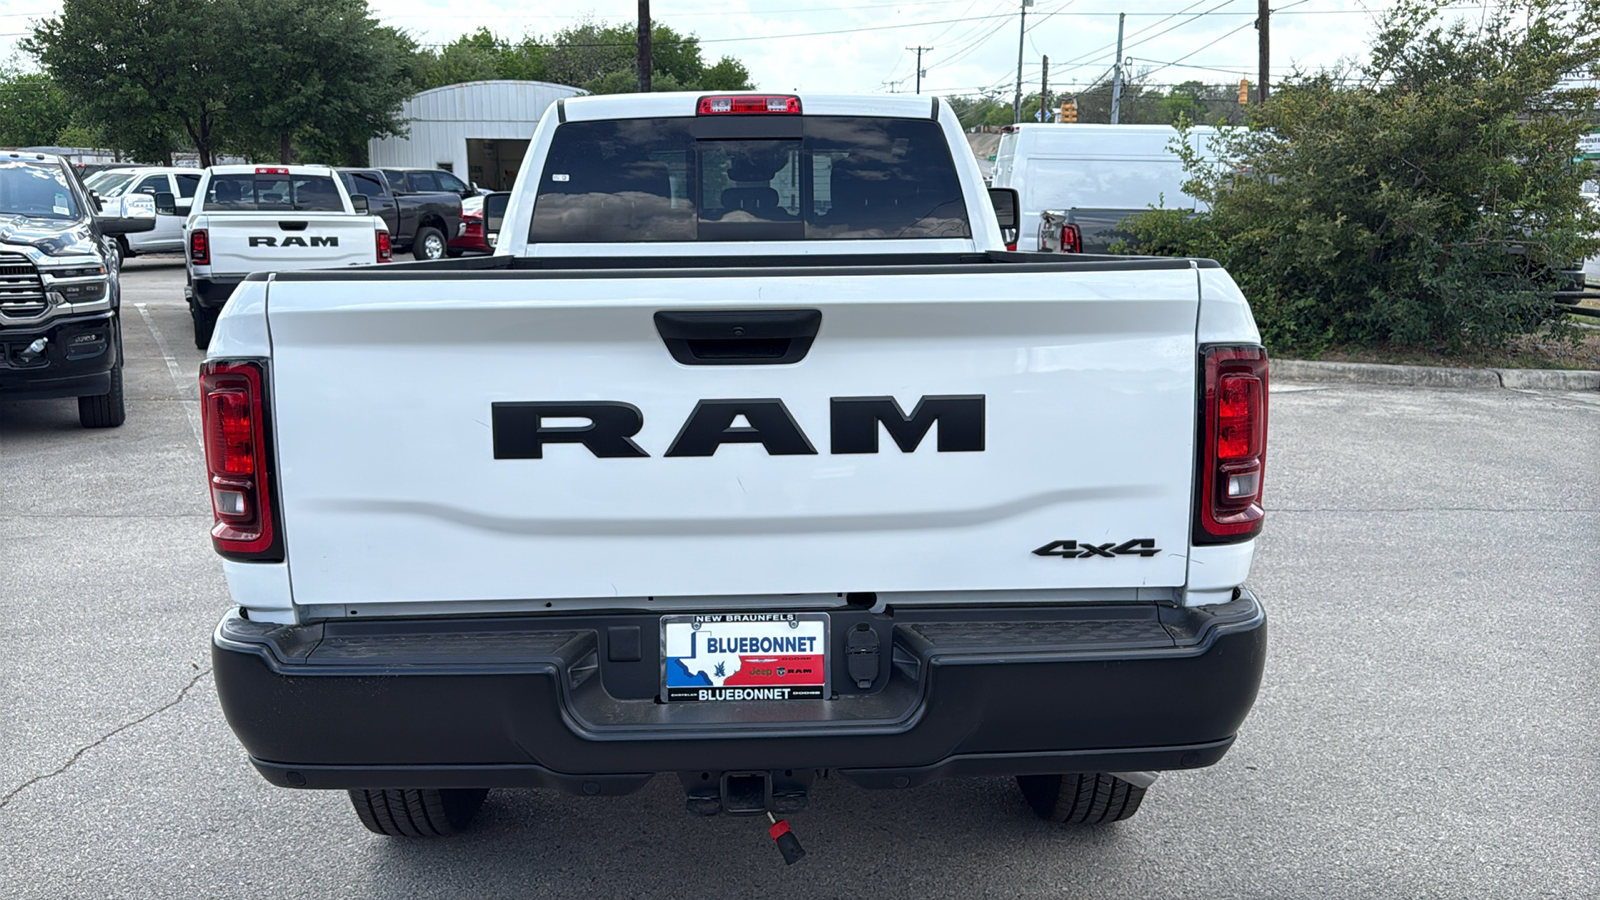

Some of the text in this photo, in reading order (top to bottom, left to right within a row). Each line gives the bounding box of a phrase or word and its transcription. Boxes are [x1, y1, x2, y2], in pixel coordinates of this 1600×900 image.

[248, 236, 339, 247] RAM
[491, 393, 986, 460] RAM
[1031, 538, 1162, 558] 4x4
[726, 614, 794, 622] BRAUNFELS
[707, 636, 817, 654] BLUEBONNET
[749, 667, 773, 676] Jeep
[698, 688, 791, 701] BLUEBONNET
